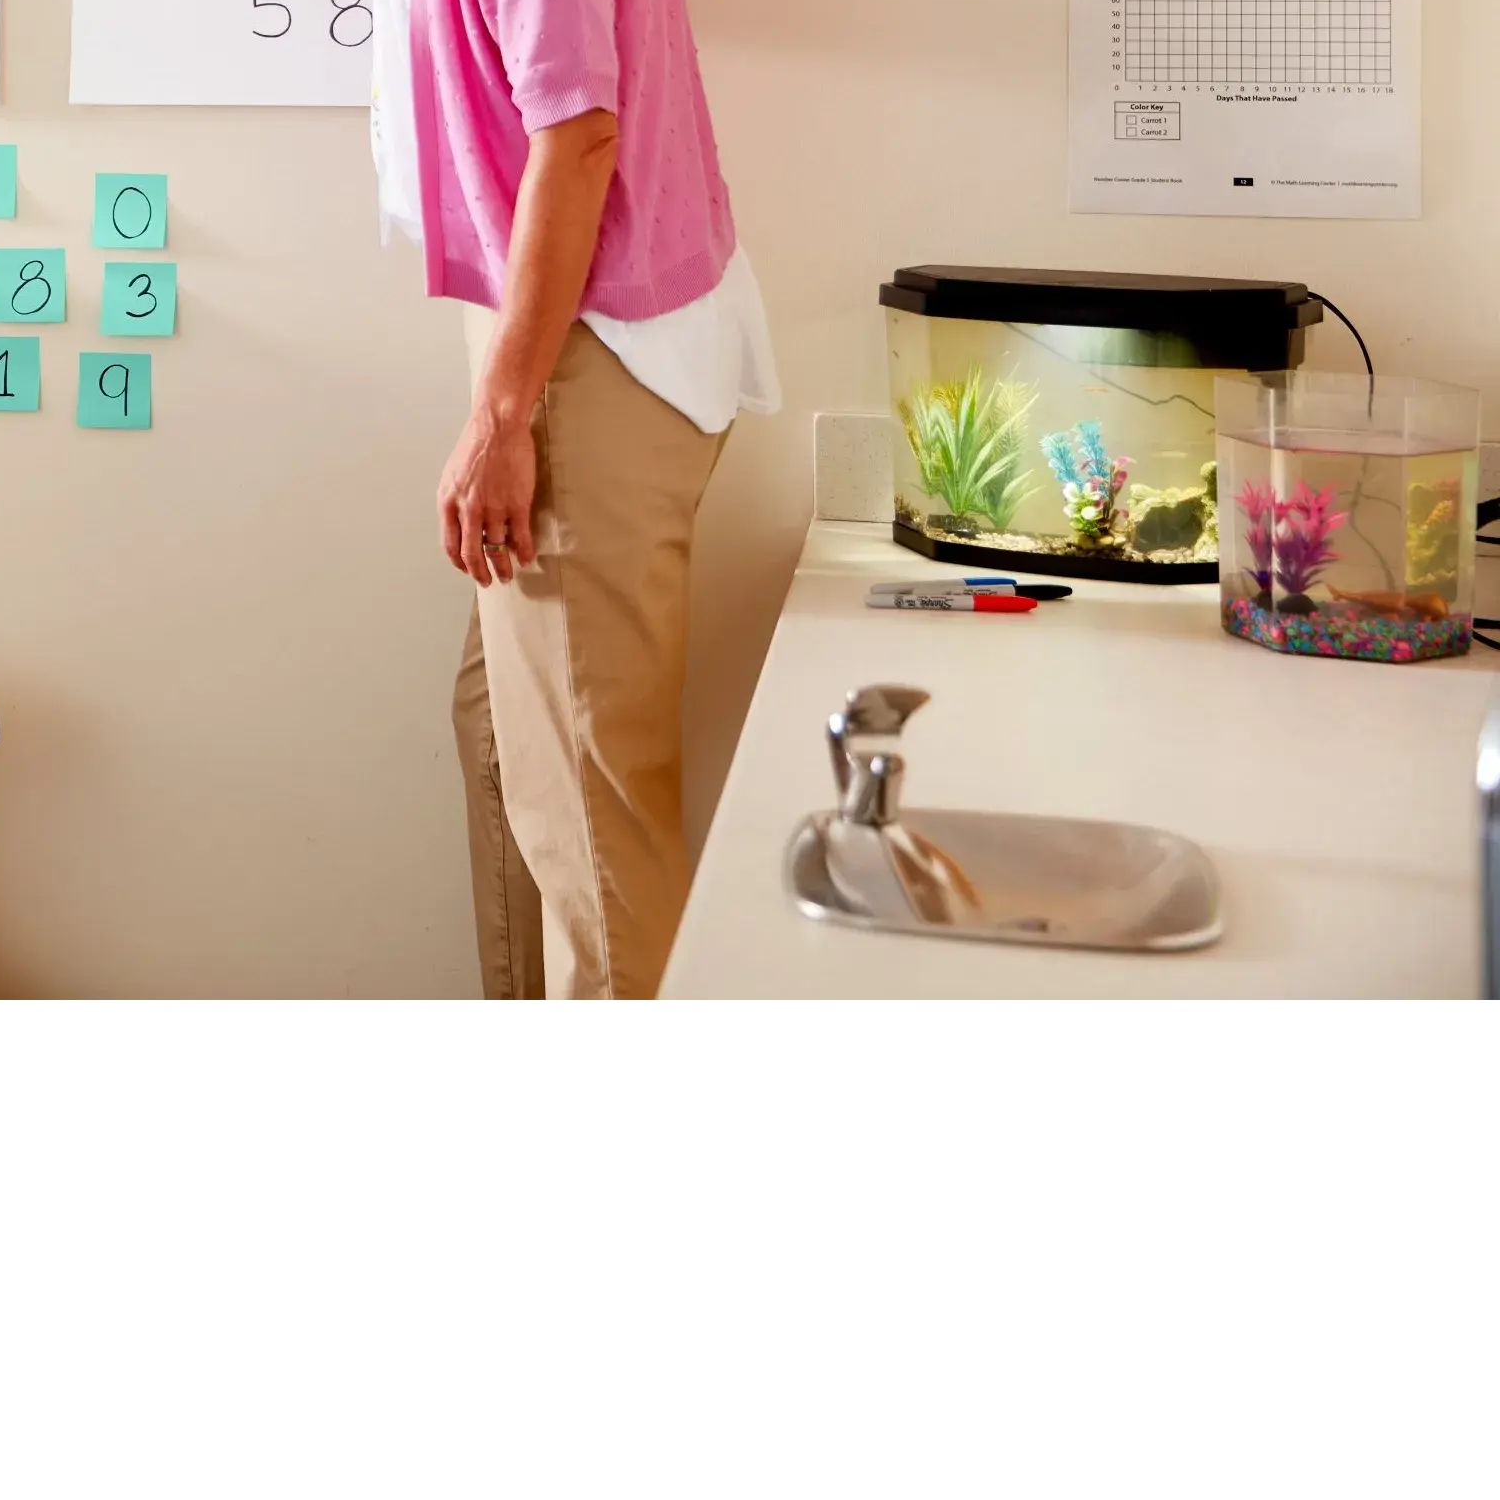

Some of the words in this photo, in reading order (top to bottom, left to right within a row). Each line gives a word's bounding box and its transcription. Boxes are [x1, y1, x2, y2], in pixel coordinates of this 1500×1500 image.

[112, 187, 152, 239] 0
[11, 260, 52, 315] 8
[126, 273, 157, 318] 3
[99, 364, 130, 417] 9
